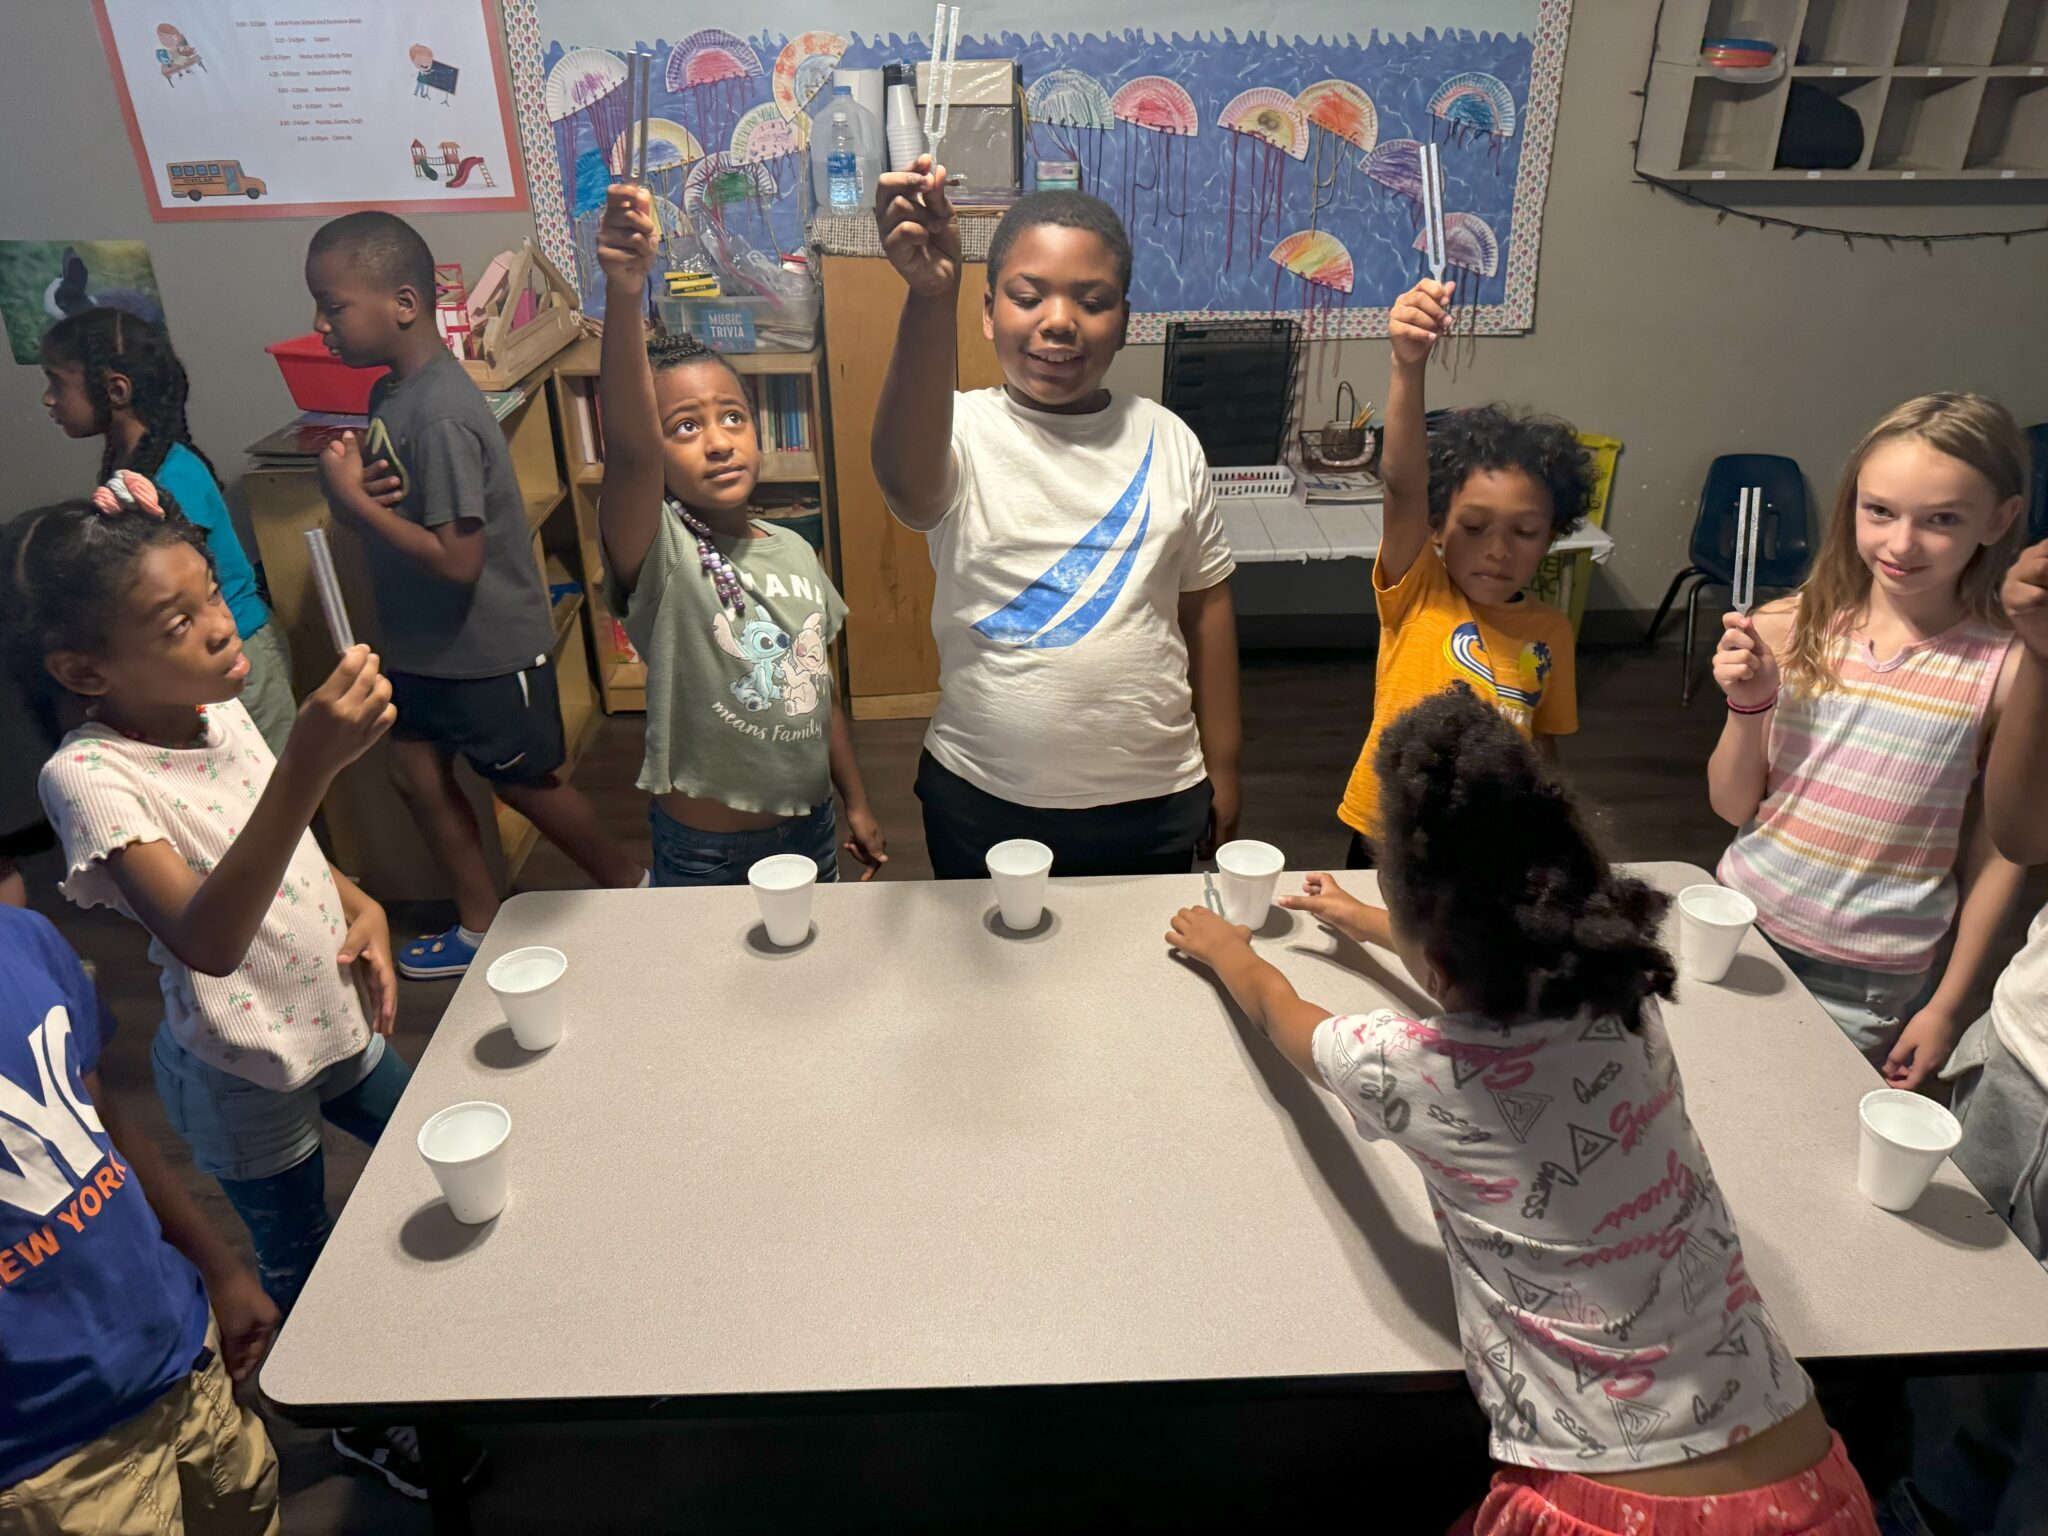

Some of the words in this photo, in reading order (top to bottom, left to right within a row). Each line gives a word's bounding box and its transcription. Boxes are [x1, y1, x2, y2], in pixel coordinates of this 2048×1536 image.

[708, 313, 742, 325] MUSIC
[709, 326, 745, 338] TRIVIA
[711, 701, 768, 740] means
[772, 717, 822, 742] Family
[0, 1225, 61, 1290] EW
